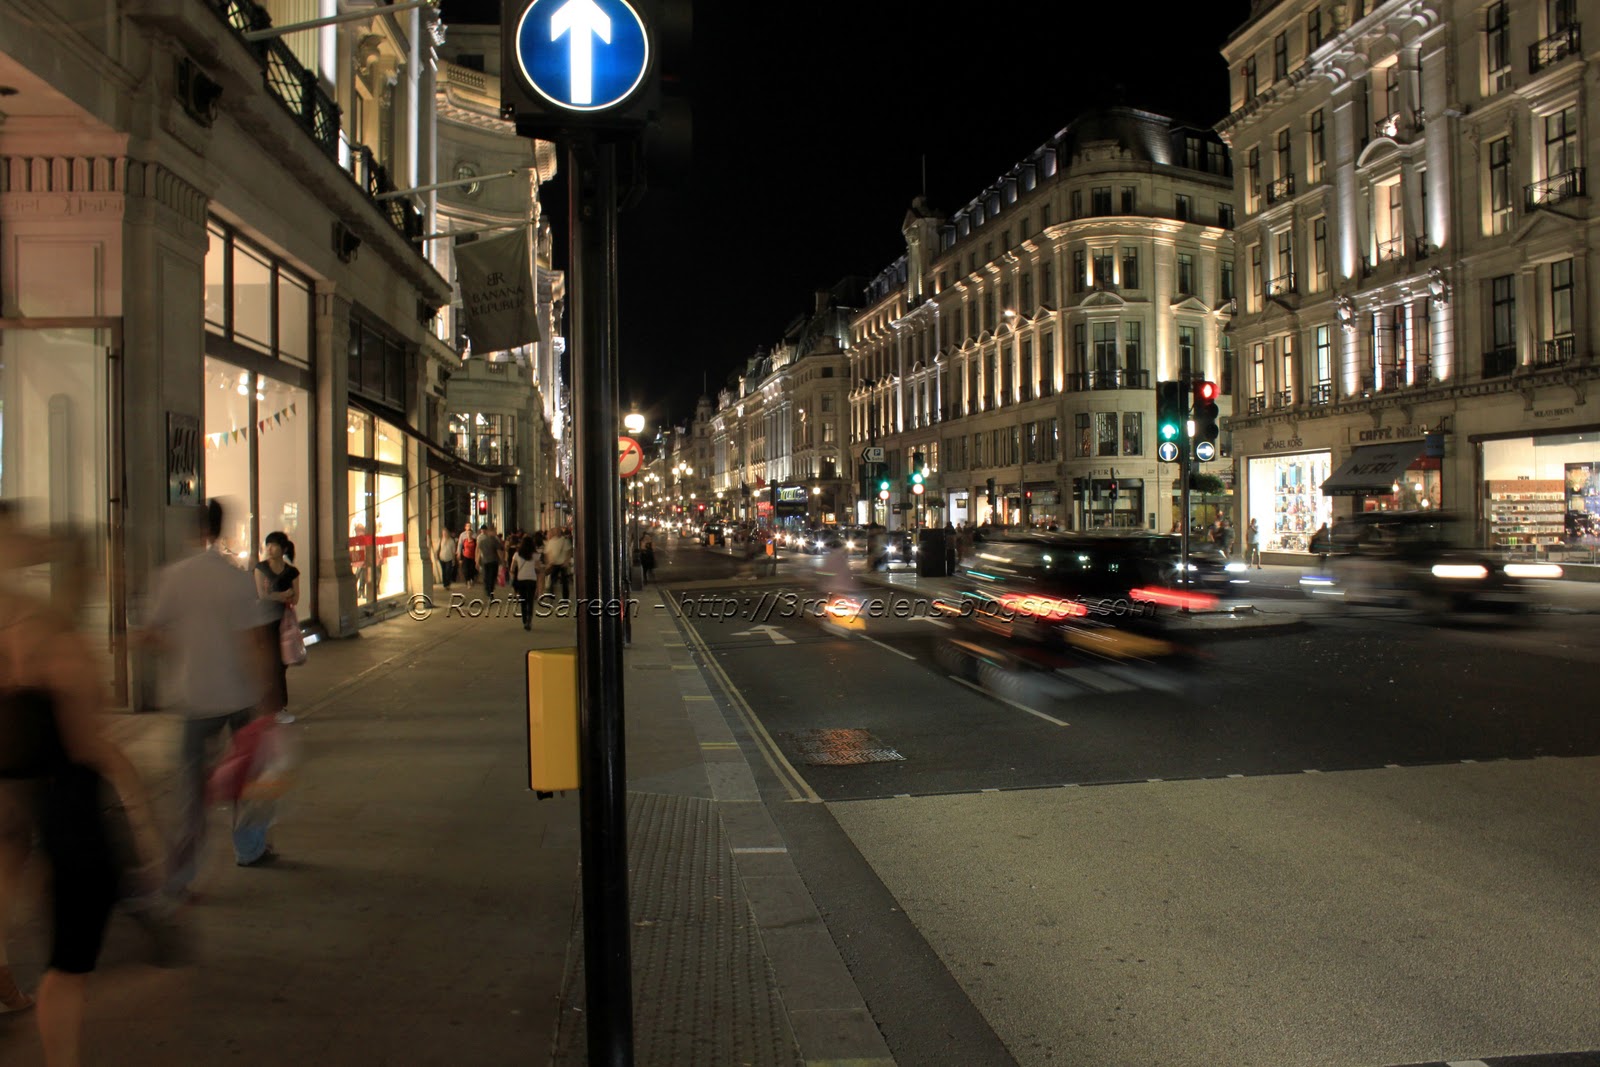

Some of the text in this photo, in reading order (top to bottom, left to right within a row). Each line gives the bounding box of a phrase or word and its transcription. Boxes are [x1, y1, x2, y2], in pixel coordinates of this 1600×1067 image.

[472, 286, 524, 303] BANANA
[471, 299, 526, 317] REPUBLIC
[1263, 437, 1304, 450] MICHAEL KORS
[1092, 468, 1120, 476] FURA
[1346, 462, 1398, 475] NERO
